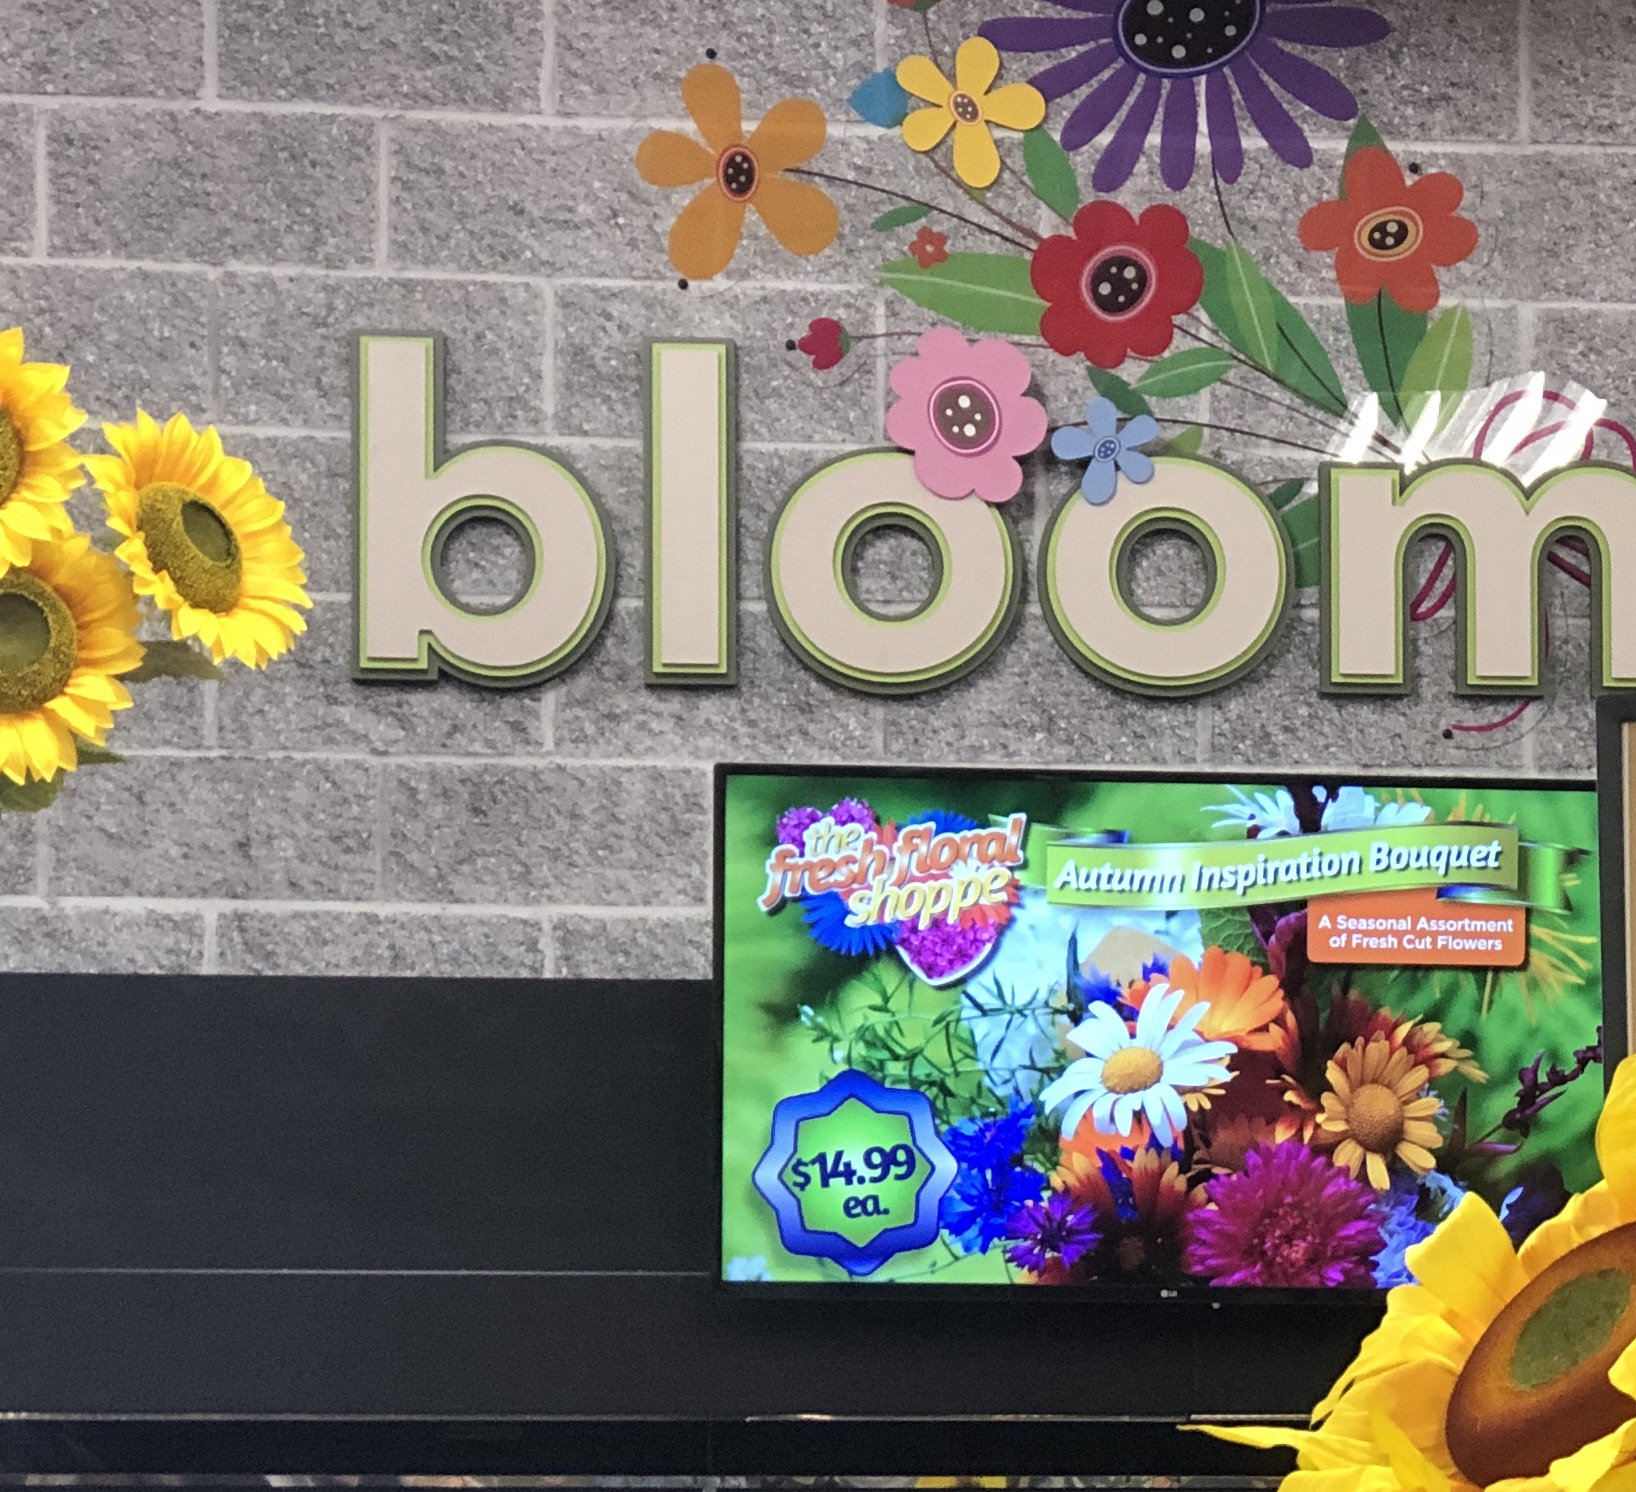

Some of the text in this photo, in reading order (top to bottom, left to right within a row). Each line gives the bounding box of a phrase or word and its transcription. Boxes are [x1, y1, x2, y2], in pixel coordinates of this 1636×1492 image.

[808, 818, 862, 856] the
[760, 815, 1024, 908] fresh floral
[1054, 840, 1502, 896] Autumn Inspiration Bouquet
[847, 870, 1012, 931] shoppe
[1319, 915, 1514, 932] A Seasonal Assortment
[1329, 934, 1502, 951] of Fresh Cut Flowers
[791, 1143, 917, 1192] $14.99
[843, 1194, 890, 1219] ea.
